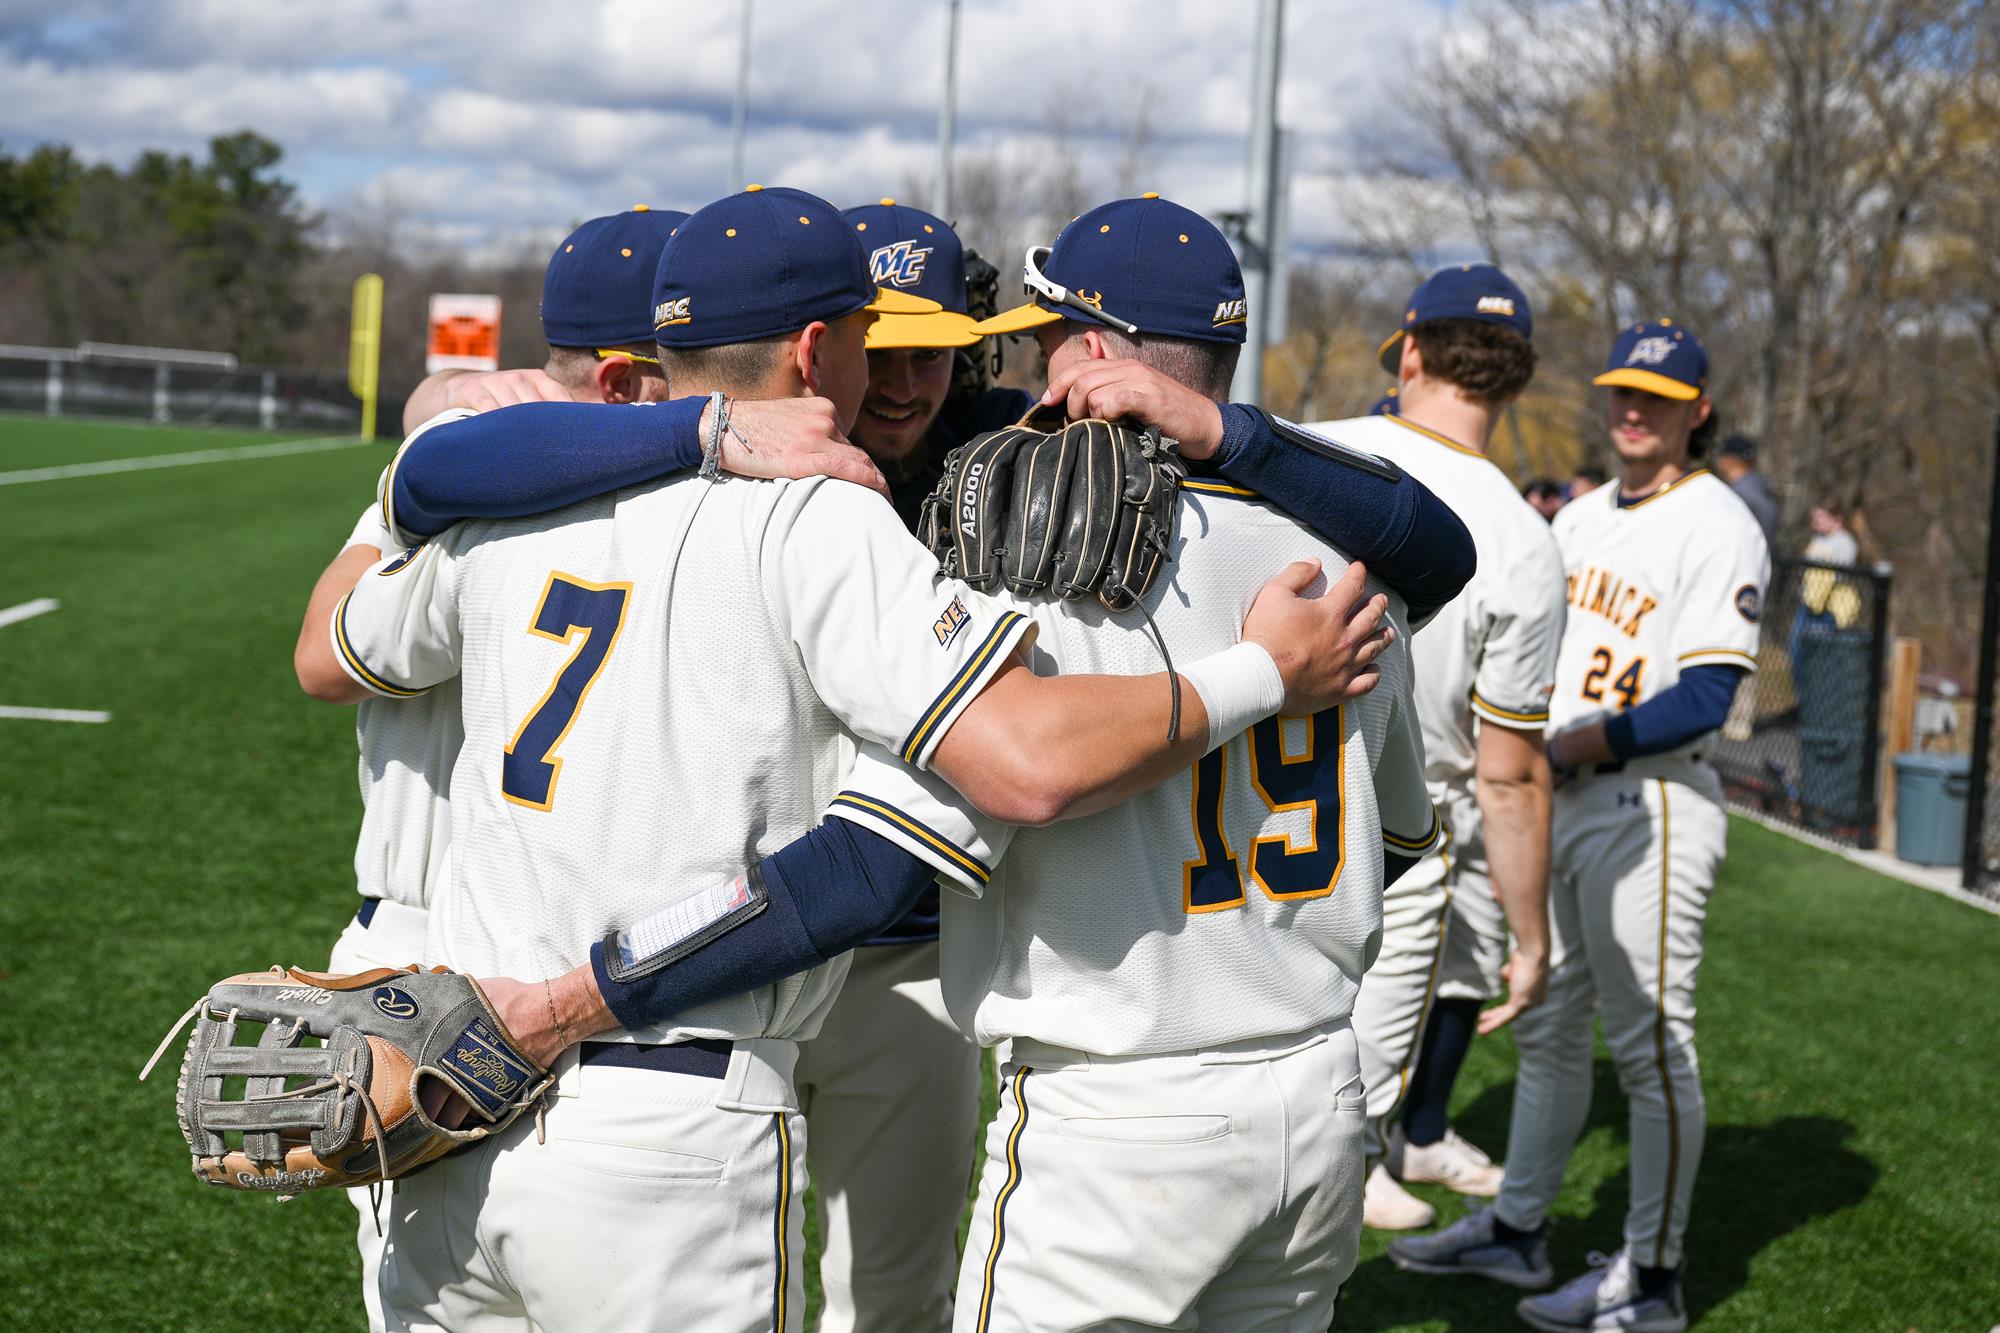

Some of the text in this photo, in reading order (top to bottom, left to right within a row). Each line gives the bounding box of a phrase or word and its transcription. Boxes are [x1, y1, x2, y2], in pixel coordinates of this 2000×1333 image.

[869, 240, 933, 287] MC
[655, 297, 691, 324] NEC
[961, 463, 984, 539] A2000
[502, 570, 634, 813] 7
[1581, 645, 1646, 713] 24
[1183, 703, 1345, 914] 19
[275, 988, 335, 1005] Elliott
[456, 1047, 518, 1094] Rawlings
[237, 1167, 326, 1188] Rawlings
